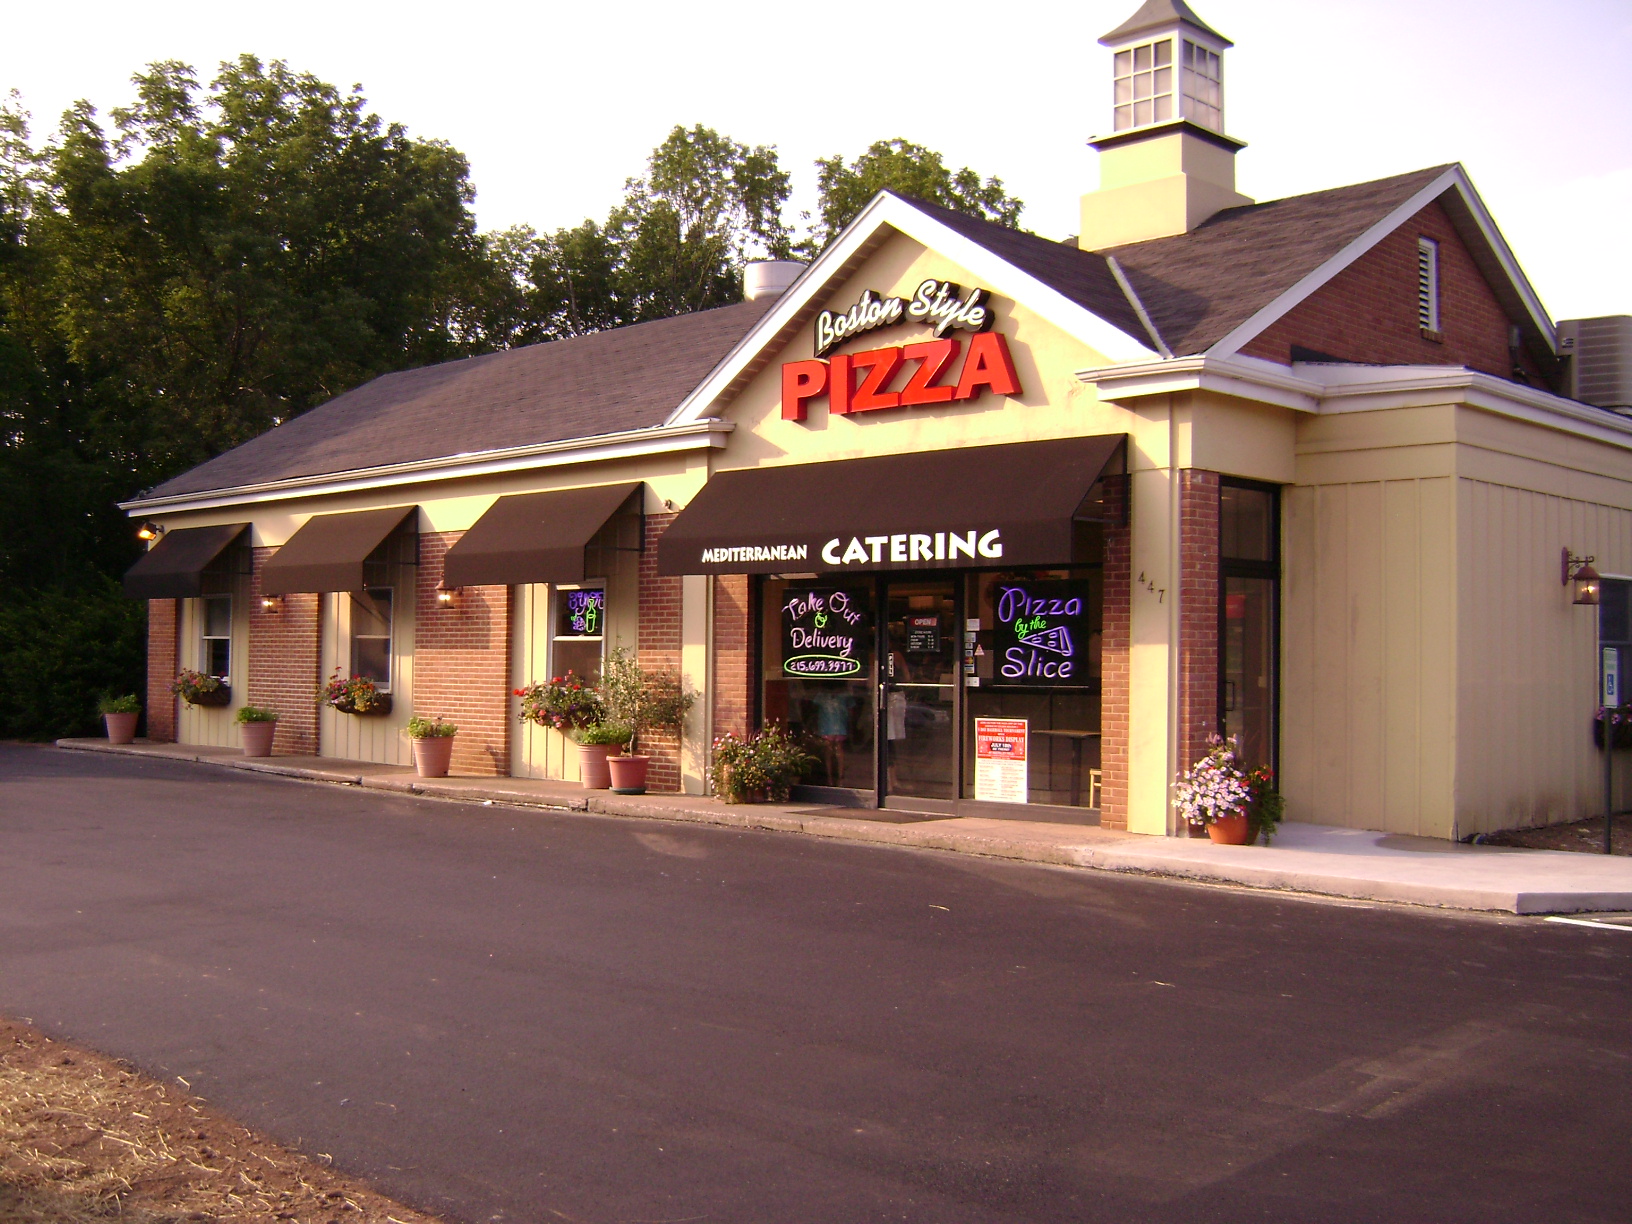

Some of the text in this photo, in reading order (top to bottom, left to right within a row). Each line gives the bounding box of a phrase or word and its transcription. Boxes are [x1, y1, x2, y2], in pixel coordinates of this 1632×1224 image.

[815, 278, 989, 354] Boston Style
[782, 331, 1023, 420] PIZZA
[701, 529, 1003, 565] MEDITERRANEAN CATERING
[1138, 570, 1165, 604] 447
[781, 592, 861, 626] Take Out
[998, 586, 1083, 623] Pizza
[914, 618, 931, 626] OPEN
[1014, 615, 1047, 640] by the
[790, 627, 854, 658] Delivery
[1000, 647, 1073, 678] Slice
